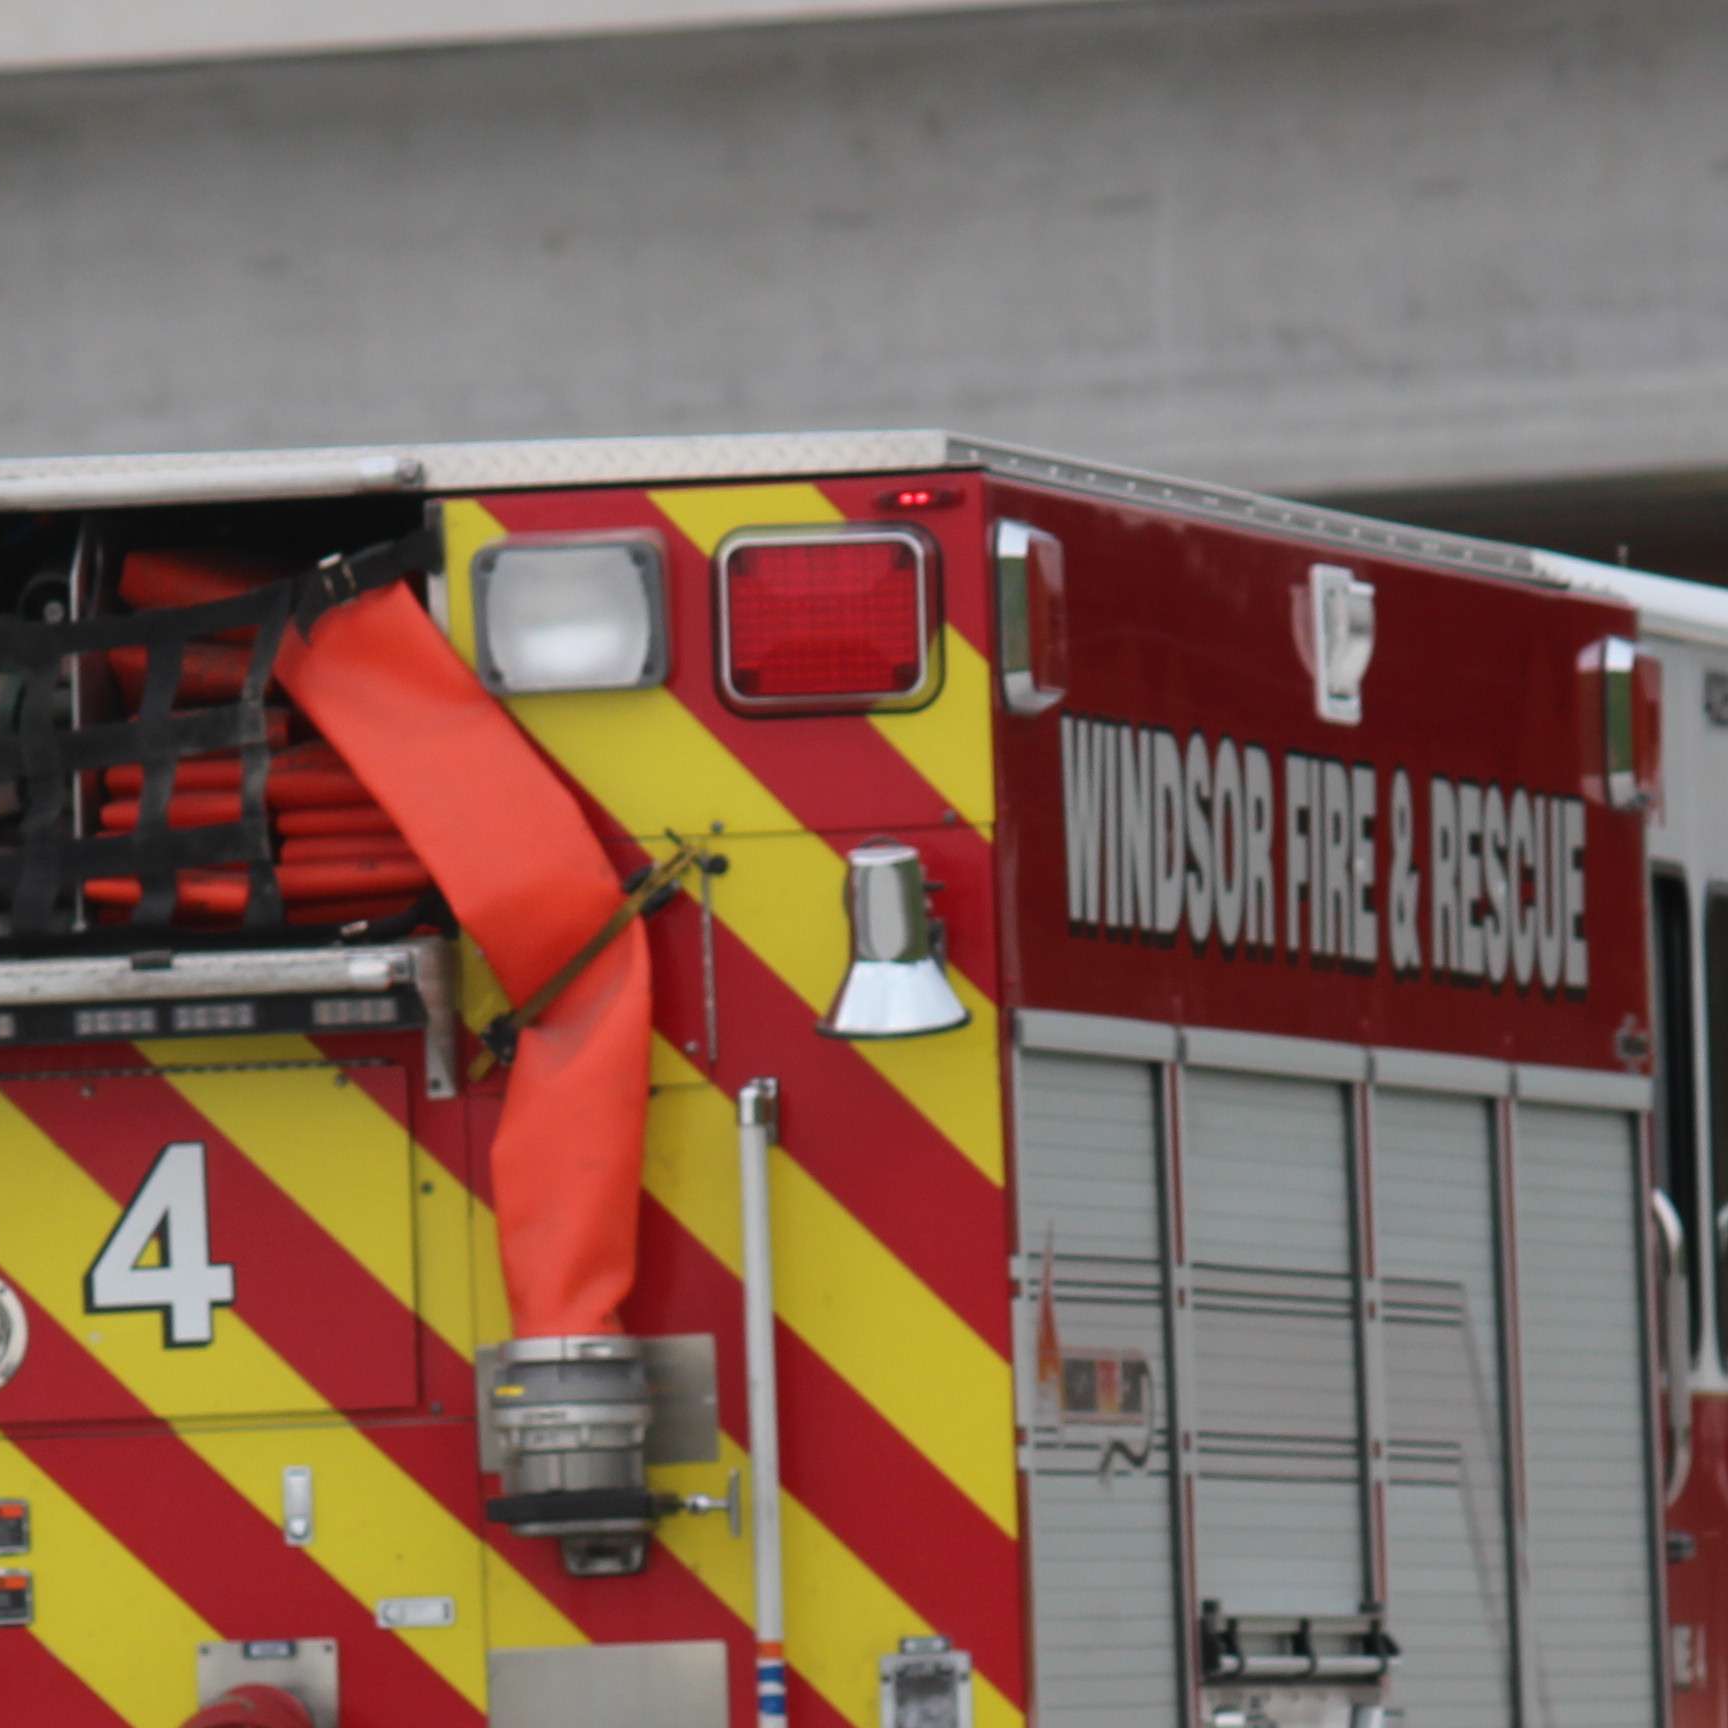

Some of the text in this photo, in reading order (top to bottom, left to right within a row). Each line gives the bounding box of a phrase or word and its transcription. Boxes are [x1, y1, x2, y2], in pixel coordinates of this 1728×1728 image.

[1060, 710, 1589, 1003] WINDSOR FIRE & RESCUE
[83, 1141, 235, 1348] 4
